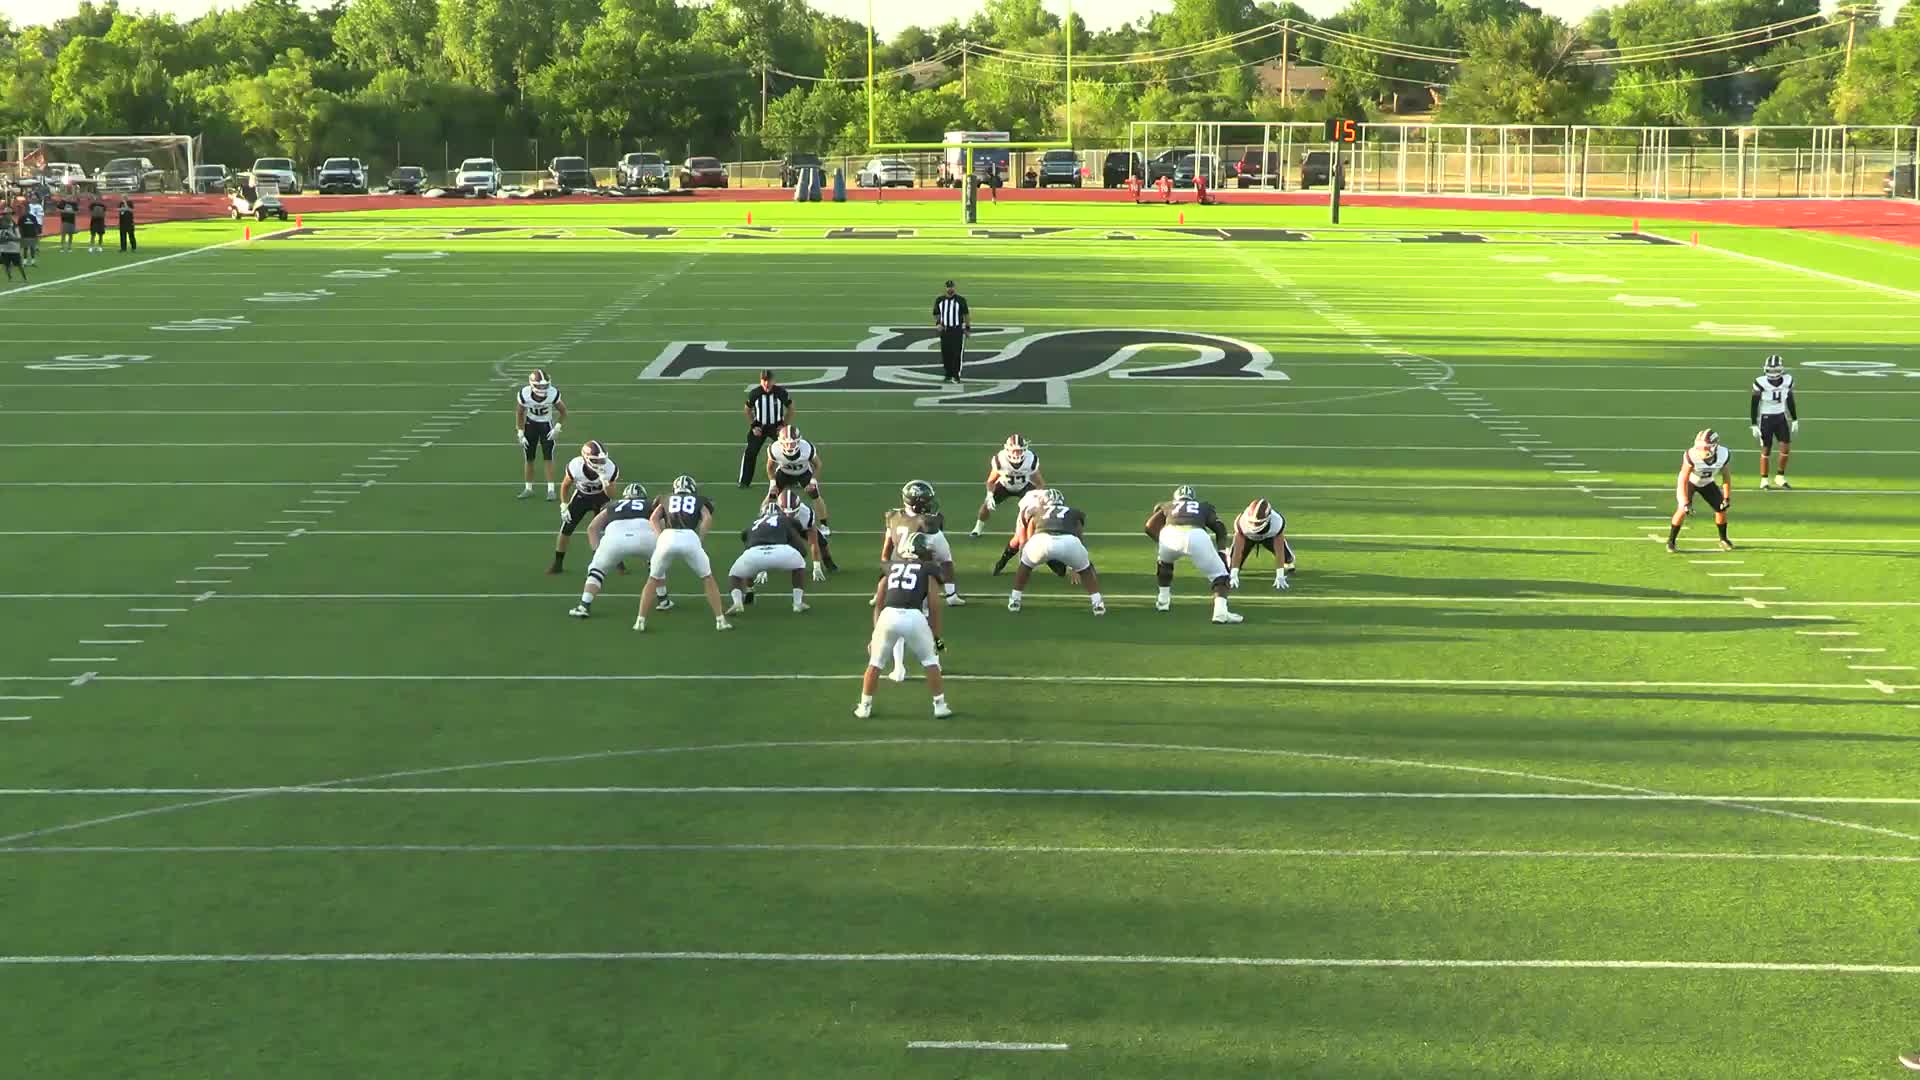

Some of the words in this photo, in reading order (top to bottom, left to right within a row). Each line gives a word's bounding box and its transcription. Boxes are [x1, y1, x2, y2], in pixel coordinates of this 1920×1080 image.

[1334, 119, 1357, 143] 15
[24, 353, 153, 371] 50
[1772, 391, 1782, 403] 4
[614, 499, 646, 513] 75
[668, 495, 697, 515] 88
[1042, 505, 1070, 519] 77
[1171, 501, 1200, 515] 72
[887, 563, 922, 590] 25
